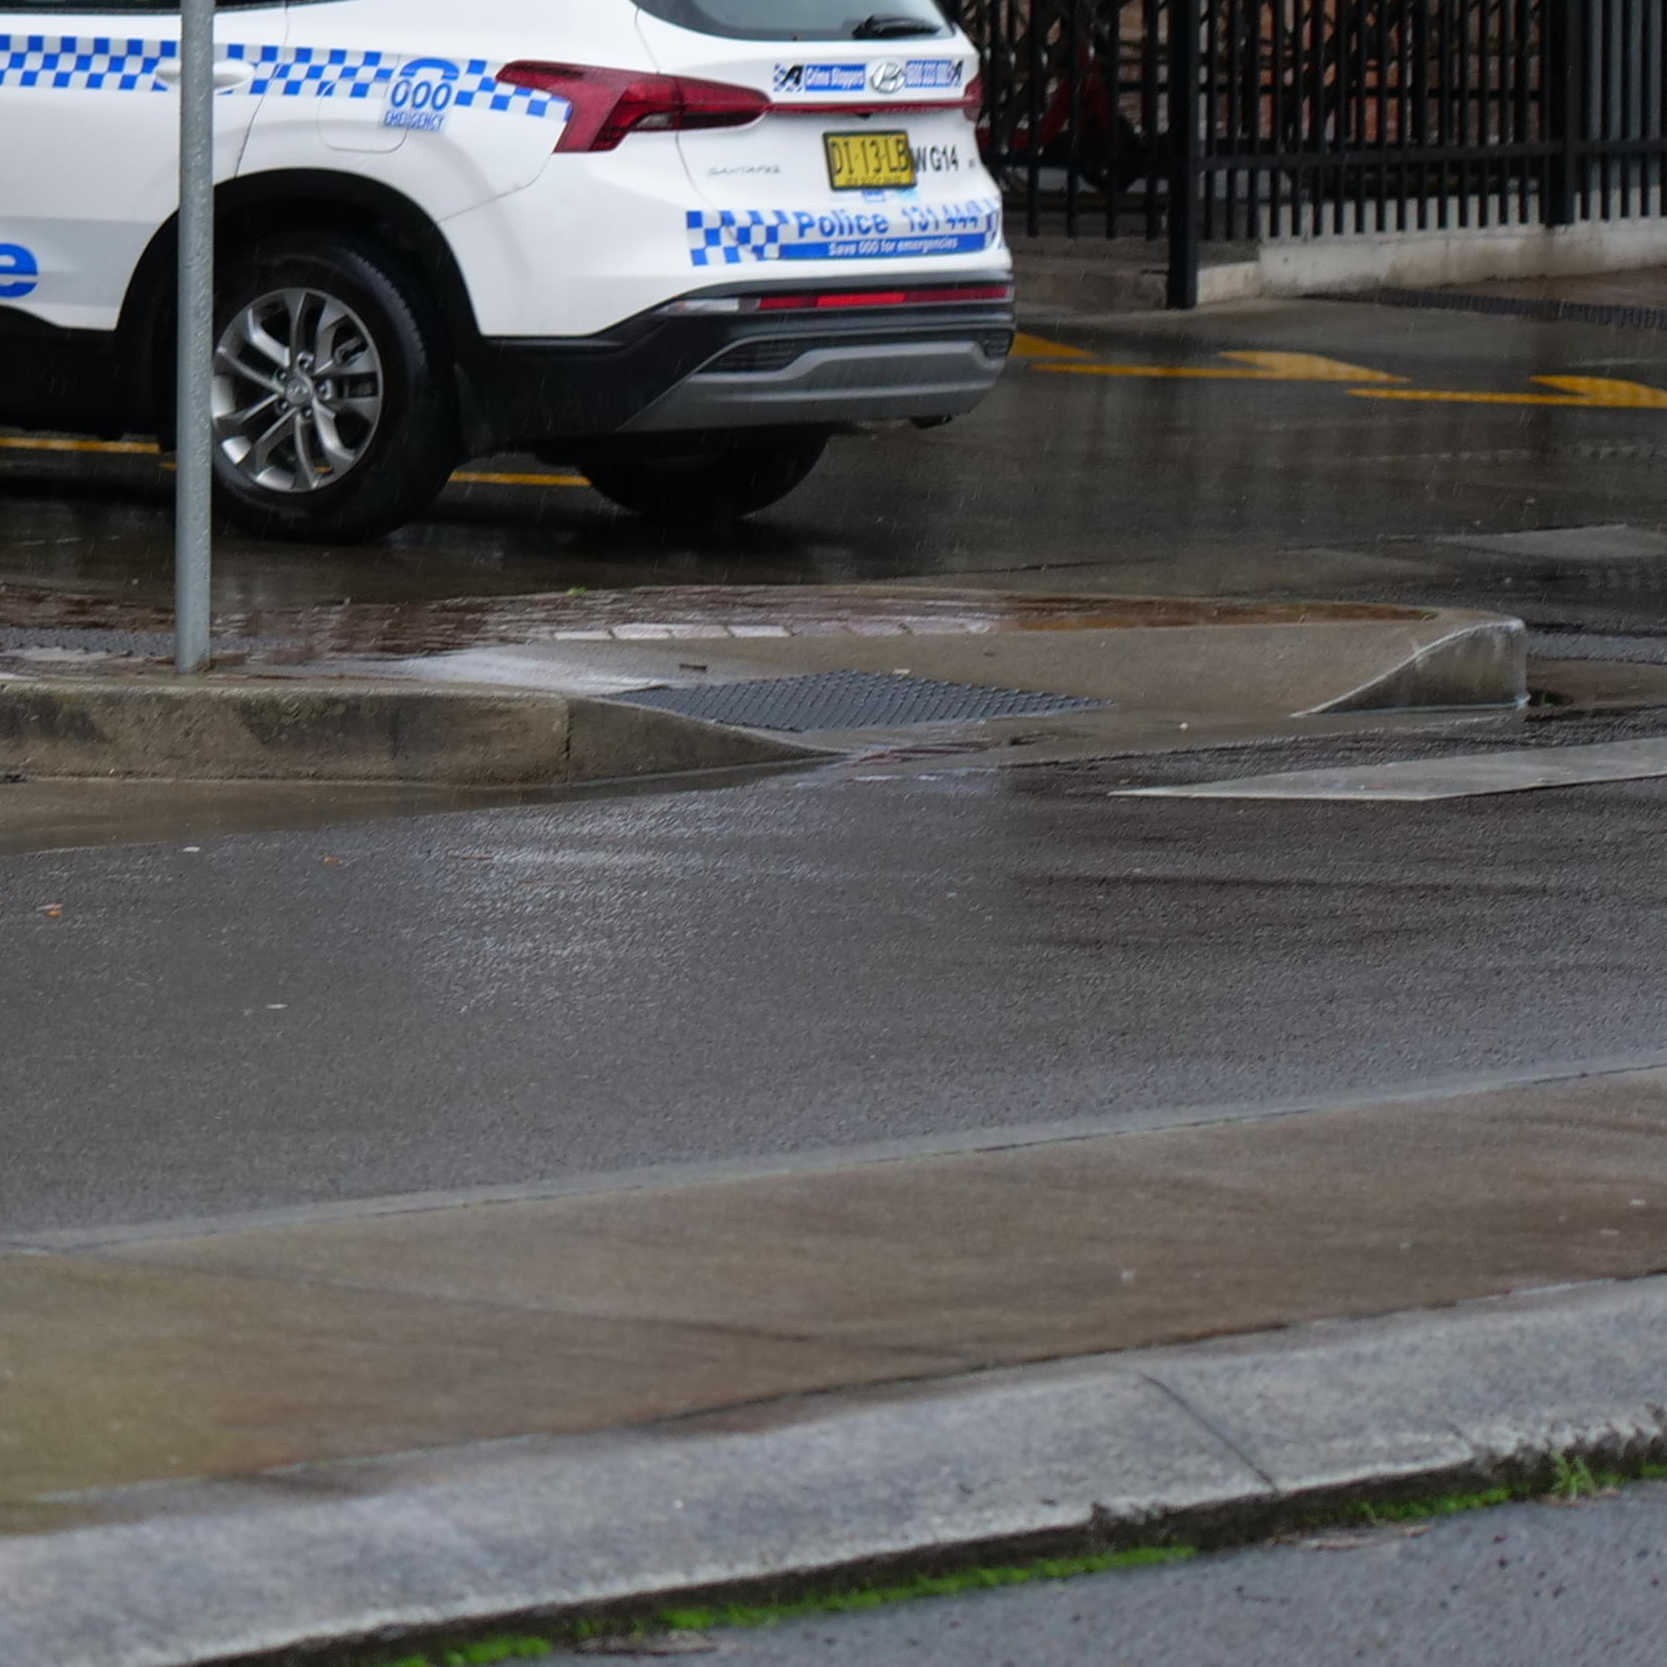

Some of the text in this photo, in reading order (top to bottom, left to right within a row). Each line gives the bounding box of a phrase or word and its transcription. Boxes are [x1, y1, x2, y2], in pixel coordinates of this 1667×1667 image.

[391, 79, 452, 112] 000
[793, 208, 889, 239] Police
[880, 236, 894, 252] for
[897, 234, 958, 254] emergencies
